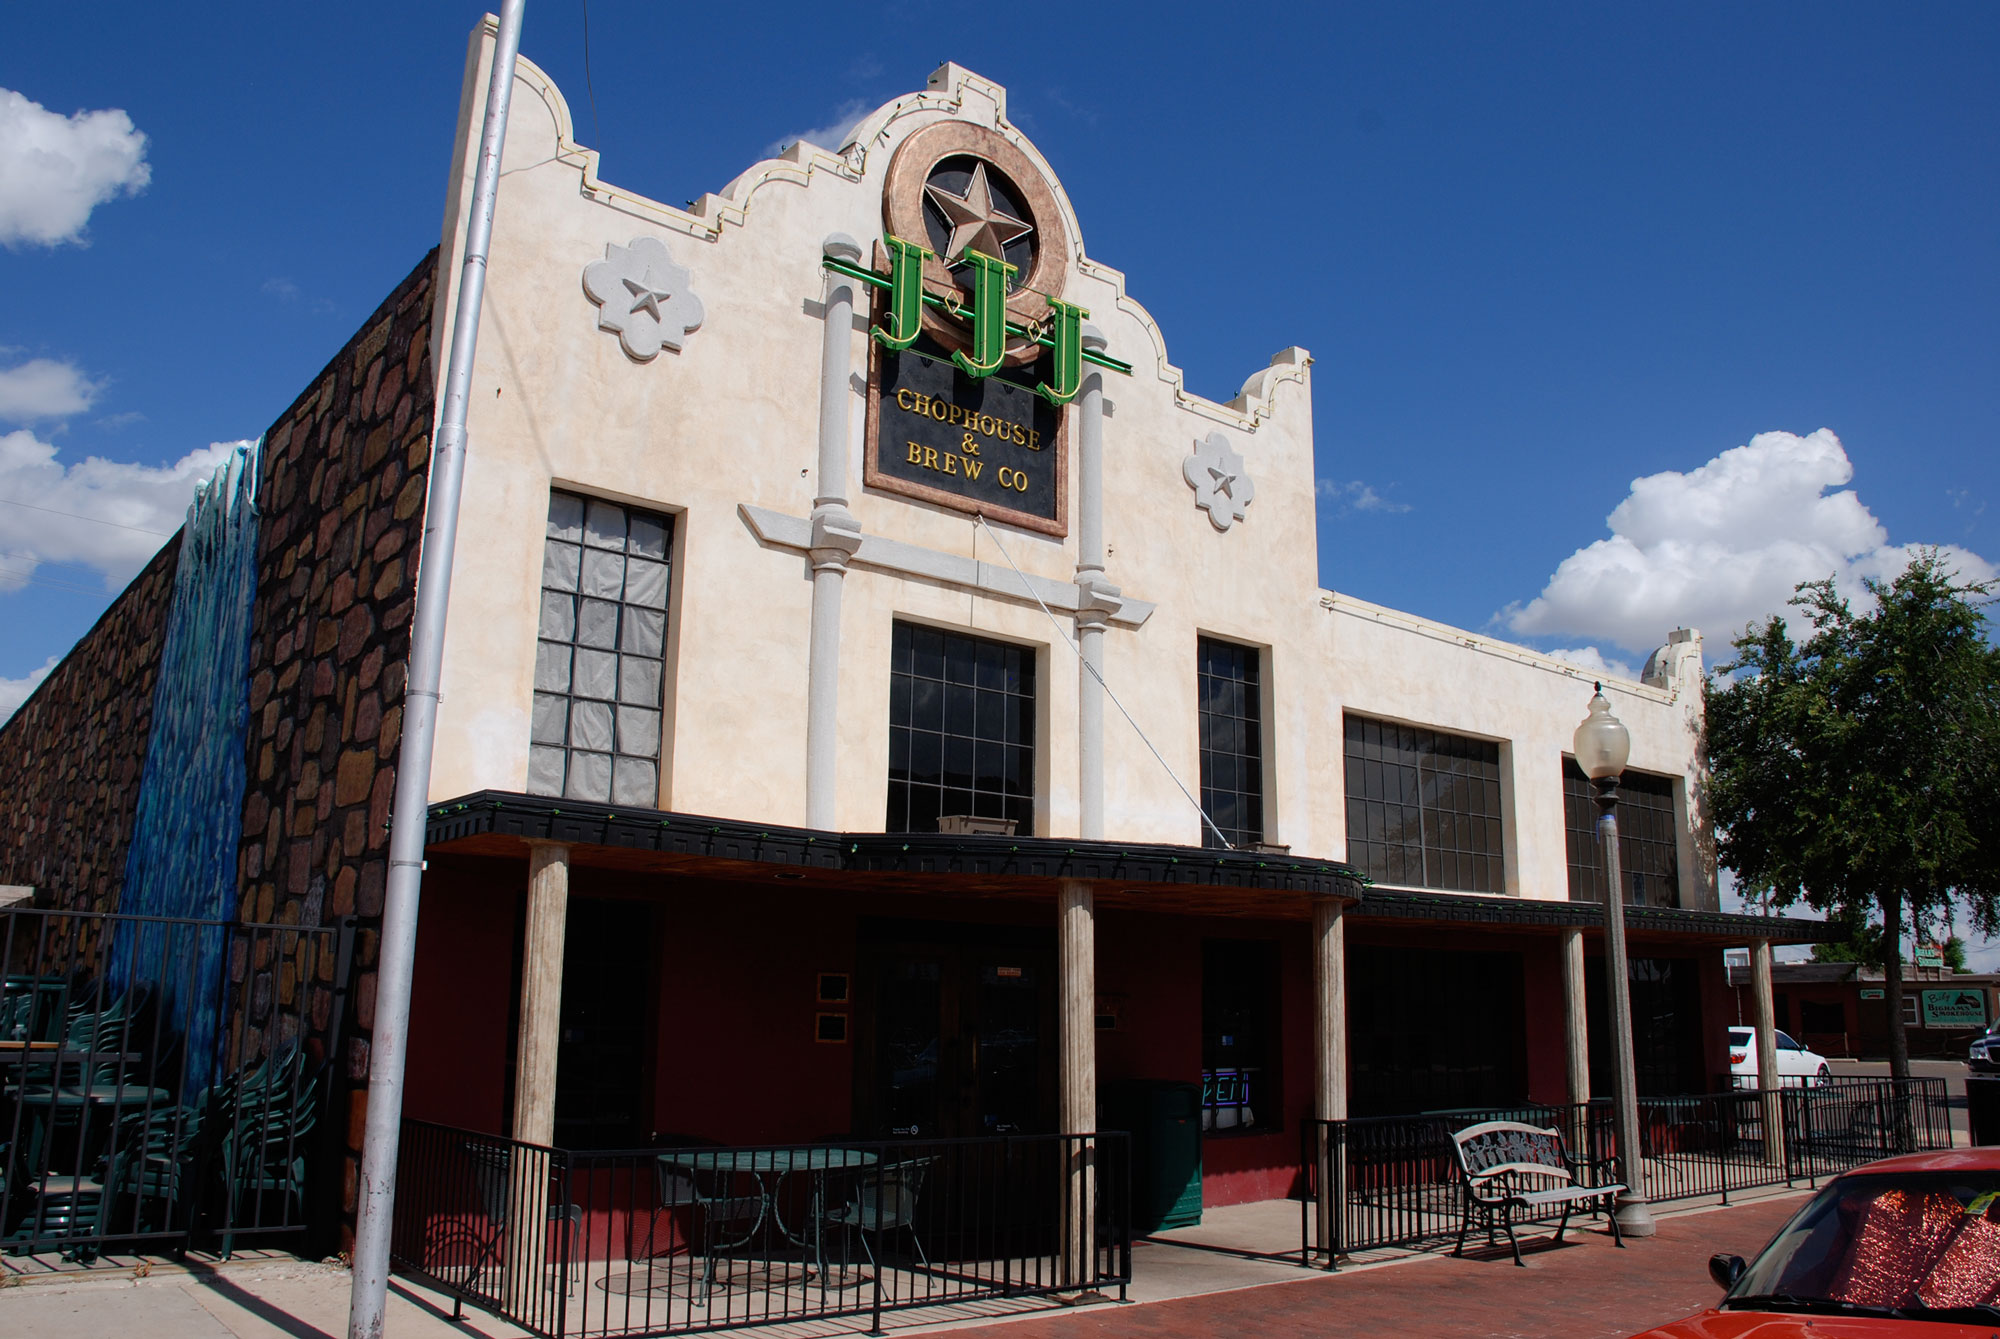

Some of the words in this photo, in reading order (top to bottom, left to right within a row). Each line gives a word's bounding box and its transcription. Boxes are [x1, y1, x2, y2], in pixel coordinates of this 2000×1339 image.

[896, 387, 1041, 451] CHOPHOUSE
[961, 432, 981, 456] &
[906, 441, 984, 481] BREW
[998, 465, 1029, 493] CO
[1932, 1010, 1983, 1018] SMOKEHOUSE
